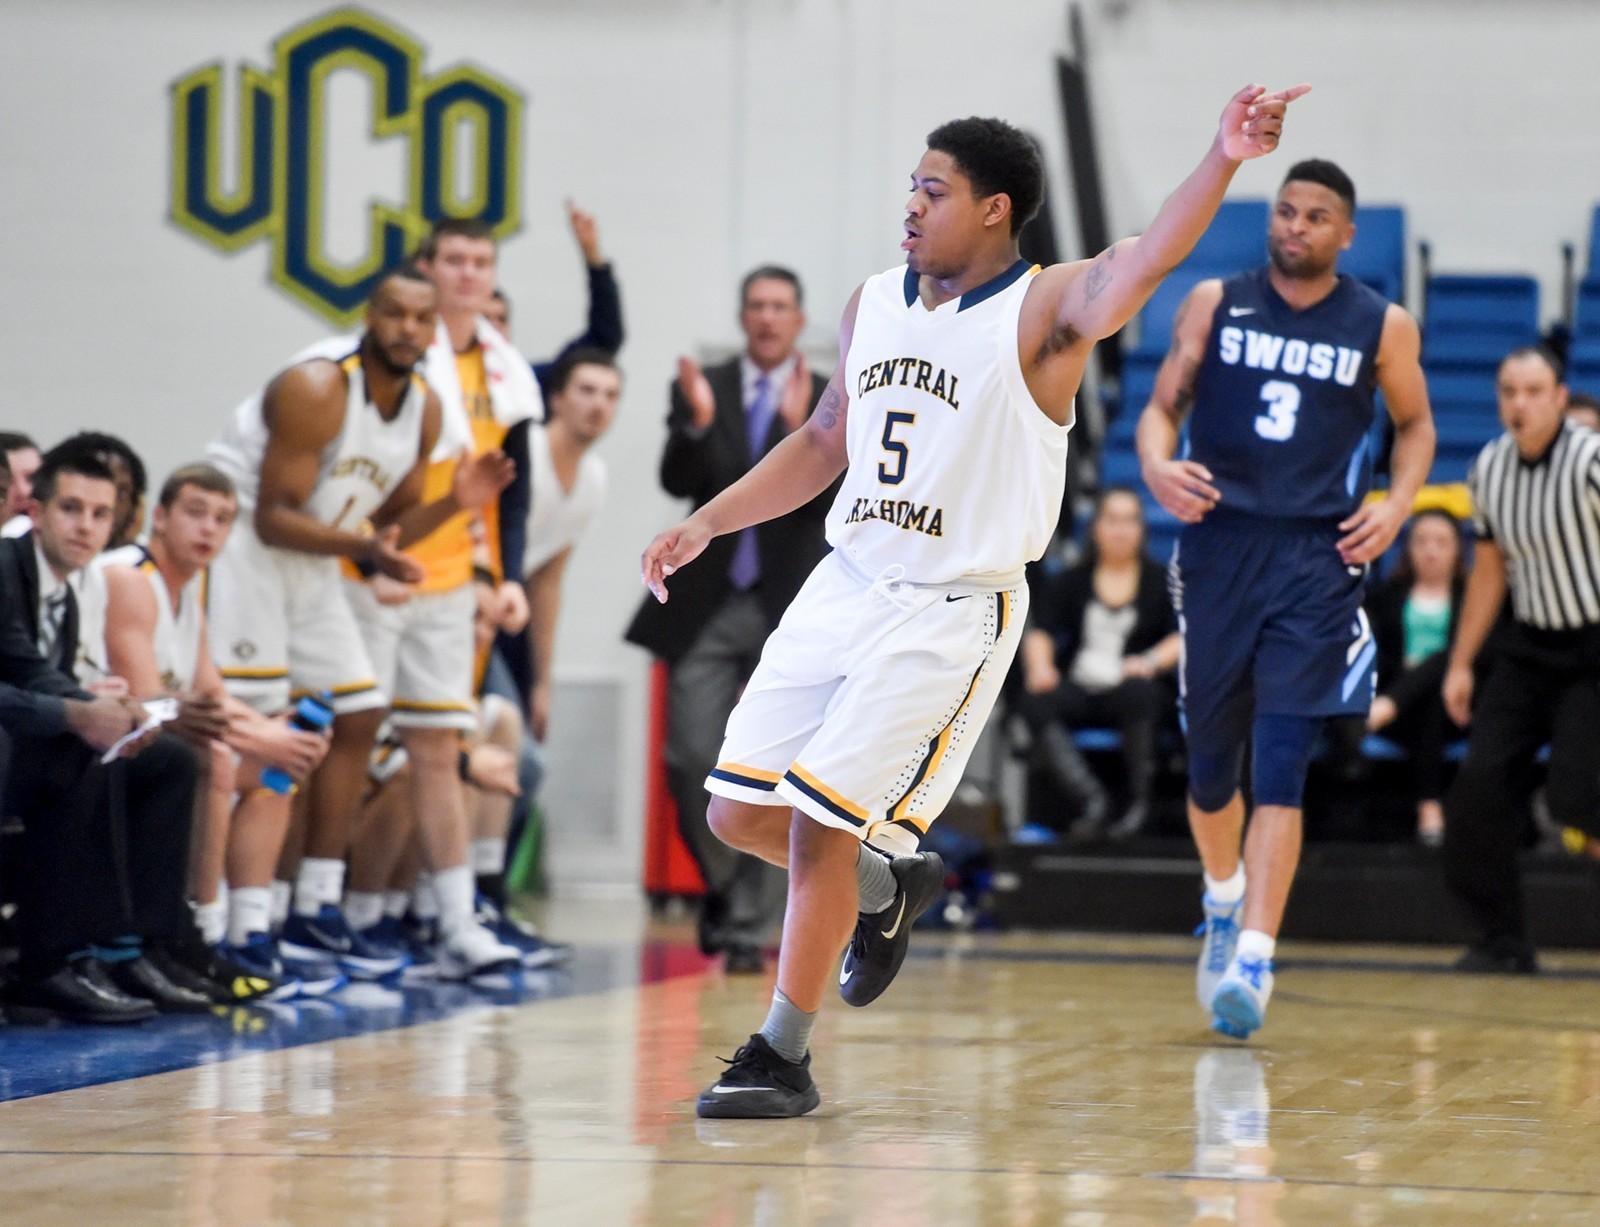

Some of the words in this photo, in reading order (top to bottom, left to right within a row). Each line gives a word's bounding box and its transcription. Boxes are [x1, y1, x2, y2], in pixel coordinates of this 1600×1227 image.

[169, 8, 523, 327] UCO
[858, 357, 959, 411] CENTRAL
[1220, 326, 1362, 386] SWOSU
[1255, 380, 1301, 441] 3
[878, 411, 917, 485] 5
[845, 497, 943, 537] KAHOMA
